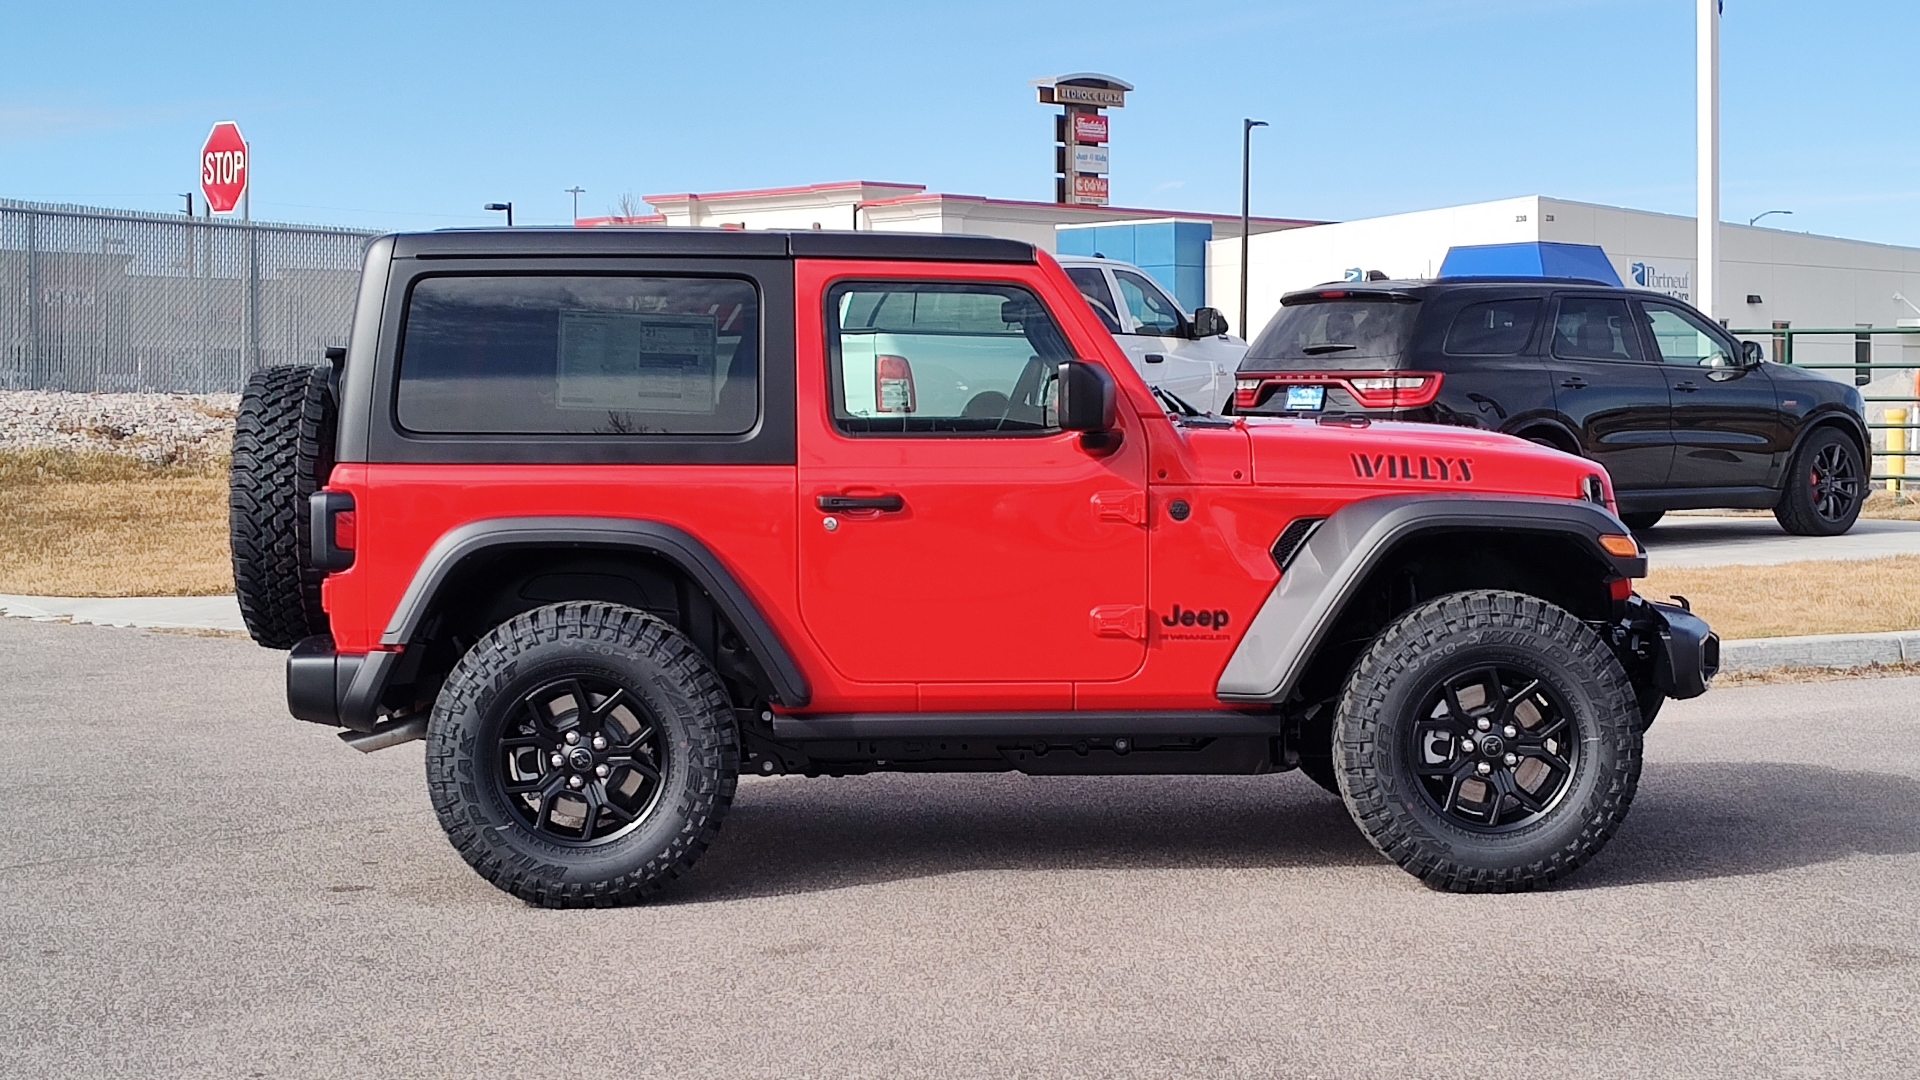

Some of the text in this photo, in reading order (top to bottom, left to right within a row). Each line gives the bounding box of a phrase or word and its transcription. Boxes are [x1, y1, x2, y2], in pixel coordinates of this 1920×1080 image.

[1061, 89, 1122, 104] BEDROCK PLAZA
[204, 151, 245, 185] STOP
[1646, 266, 1689, 289] Portneuf
[1350, 453, 1473, 481] WILLYS
[1161, 604, 1229, 631] Jeep
[1479, 630, 1616, 746] WILDPEAK
[458, 728, 569, 880] WILDPEAK
